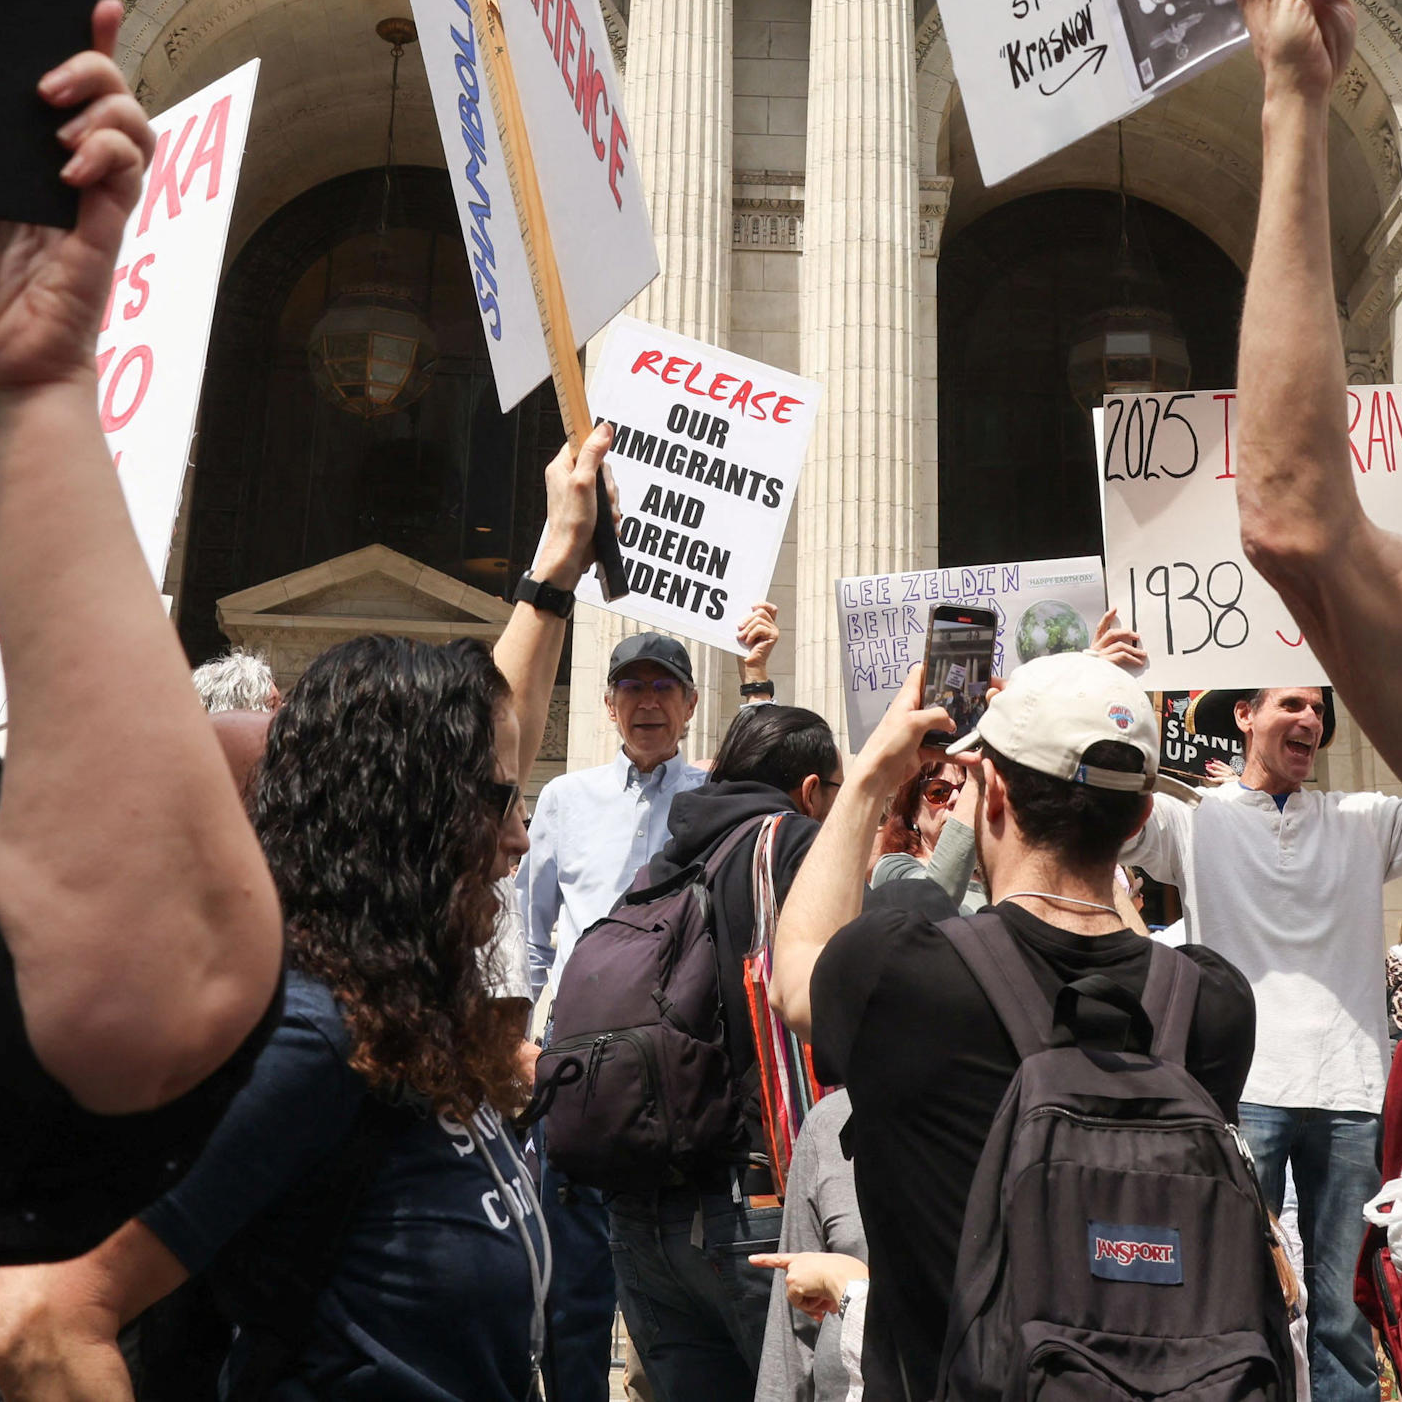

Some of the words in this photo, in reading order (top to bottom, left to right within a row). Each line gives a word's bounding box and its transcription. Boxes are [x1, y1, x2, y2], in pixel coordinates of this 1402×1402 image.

[137, 95, 232, 238] KA
[631, 350, 805, 424] RELEASE
[666, 403, 730, 449] OUR
[1104, 394, 1198, 482] 2025
[639, 483, 706, 530] AND
[618, 514, 731, 580] OREIGN
[844, 577, 891, 608] LEE
[901, 564, 1020, 602] ZELDIN
[1129, 561, 1249, 655] 1938
[848, 637, 909, 668] THE
[1166, 739, 1198, 763] UP
